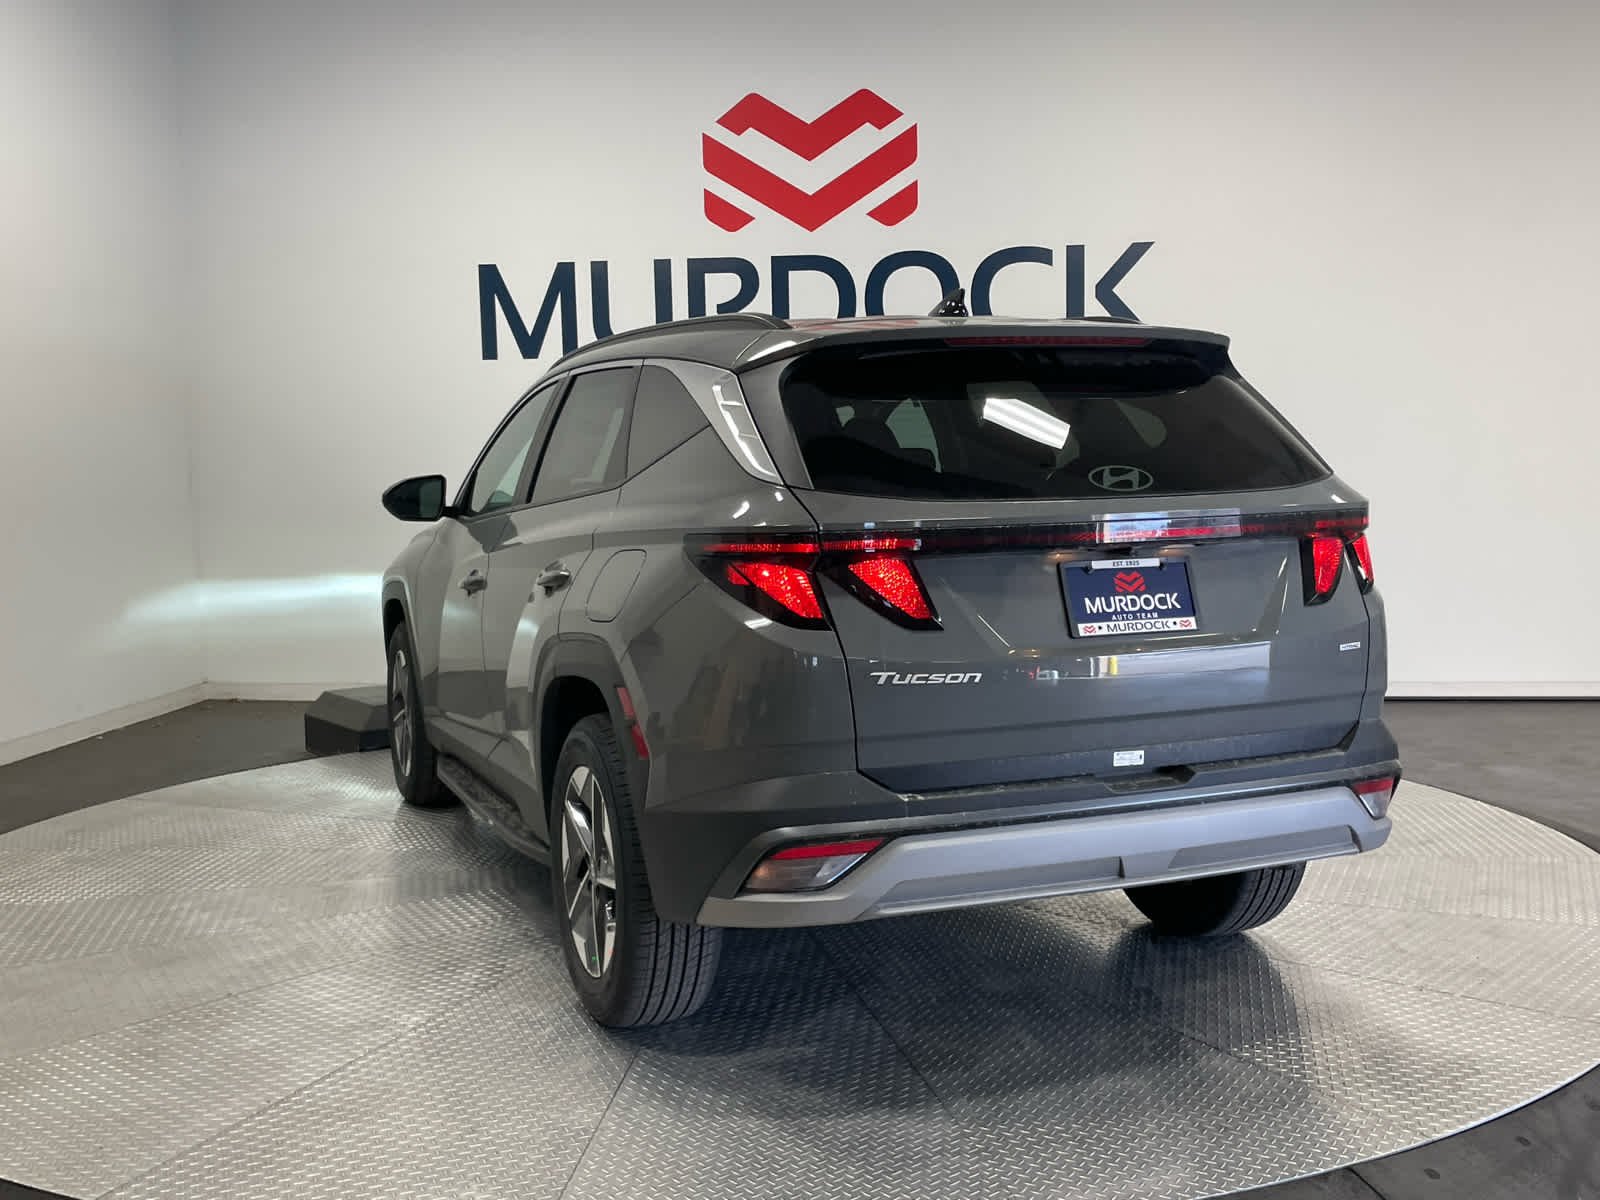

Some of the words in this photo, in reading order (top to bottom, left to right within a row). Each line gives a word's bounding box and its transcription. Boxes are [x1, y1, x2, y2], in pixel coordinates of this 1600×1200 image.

[478, 241, 1155, 361] MURDOCK
[1084, 593, 1181, 614] MURDOCK
[1111, 613, 1133, 621] AUTO
[1136, 612, 1158, 620] TEAM
[1106, 620, 1170, 632] MURDOCK
